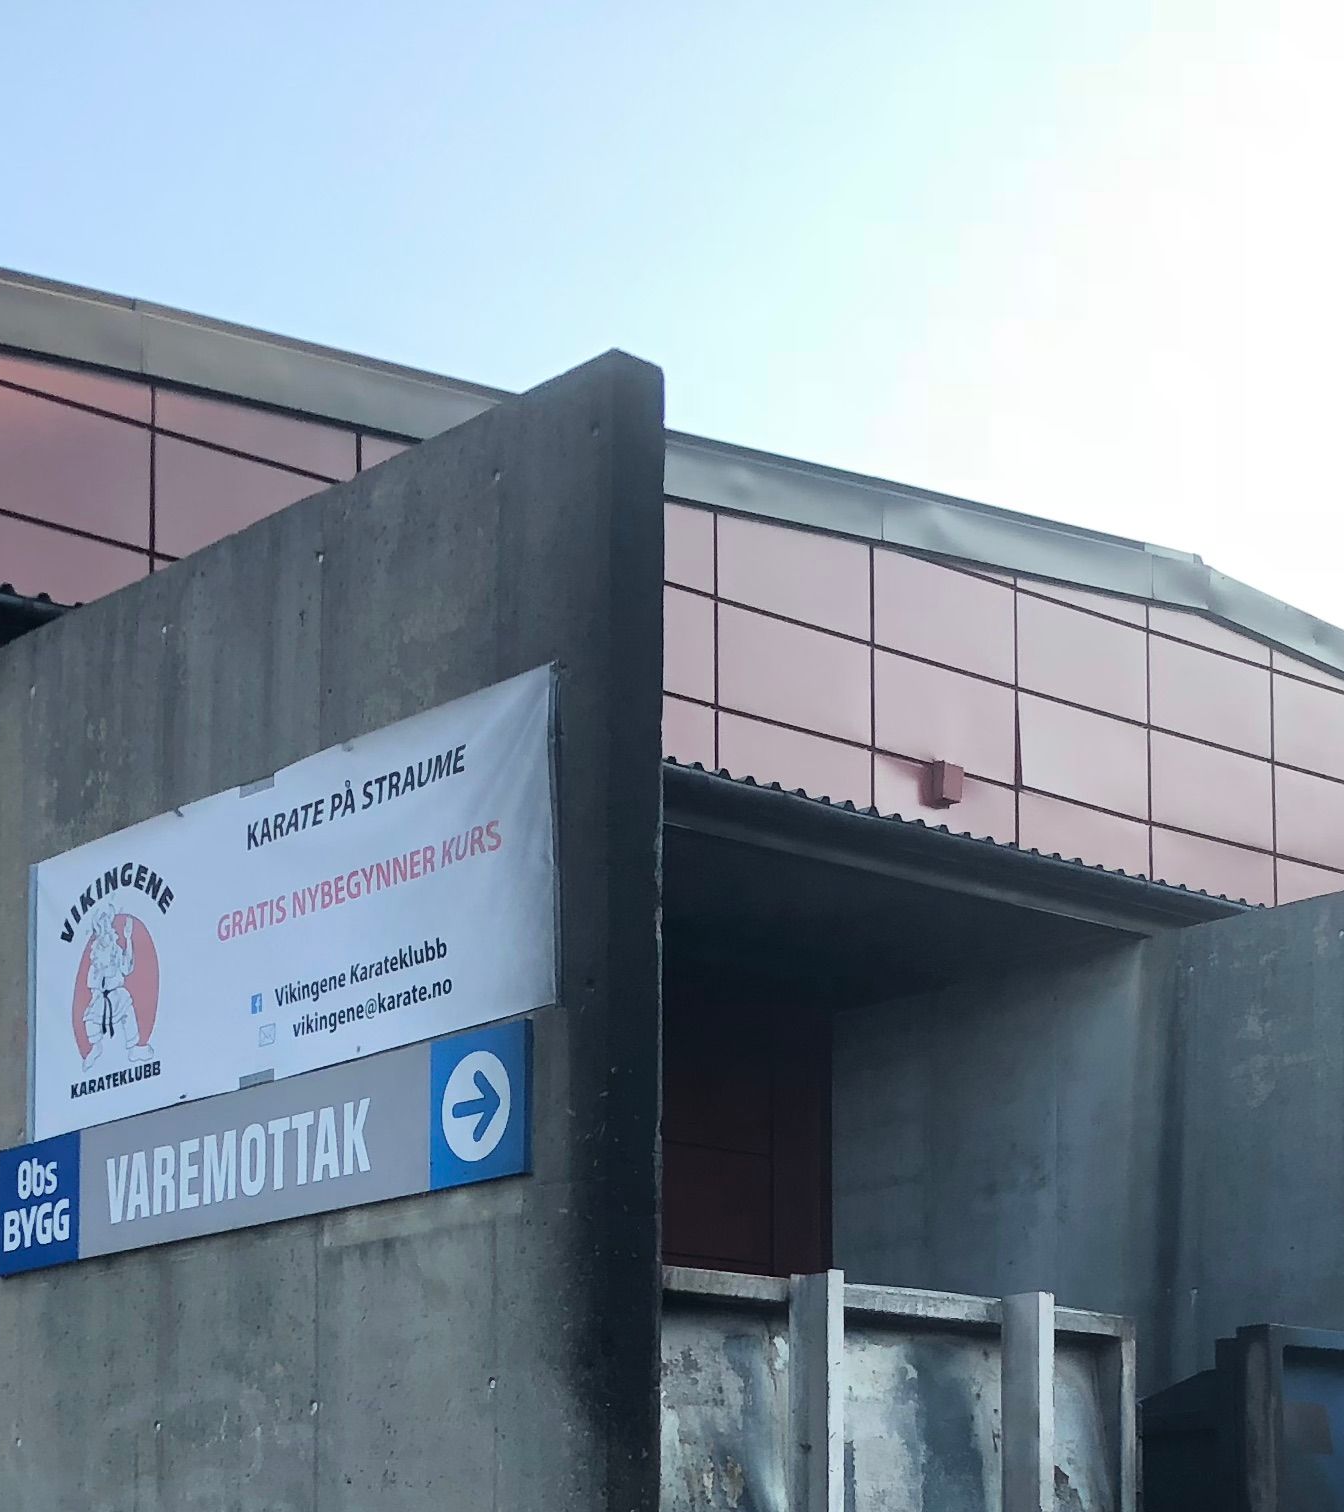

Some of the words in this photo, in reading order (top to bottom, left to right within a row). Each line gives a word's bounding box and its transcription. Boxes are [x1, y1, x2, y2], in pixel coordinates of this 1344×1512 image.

[246, 799, 325, 851] KARATE
[328, 779, 356, 822] PÅ
[361, 743, 467, 810] STRAUME
[59, 861, 175, 943] VIKINGENE
[216, 895, 287, 942] GRATIS
[291, 844, 436, 919] NYBEGYNNER
[440, 819, 503, 869] KURS
[274, 971, 346, 1007] Vikingene
[349, 936, 448, 984] Karateklubb
[292, 977, 453, 1038] vikingene@karate.no
[69, 1060, 162, 1100] KARATEKLUBB
[105, 1097, 372, 1225] VAREMOTTAK
[2, 1197, 71, 1253] BYGG
